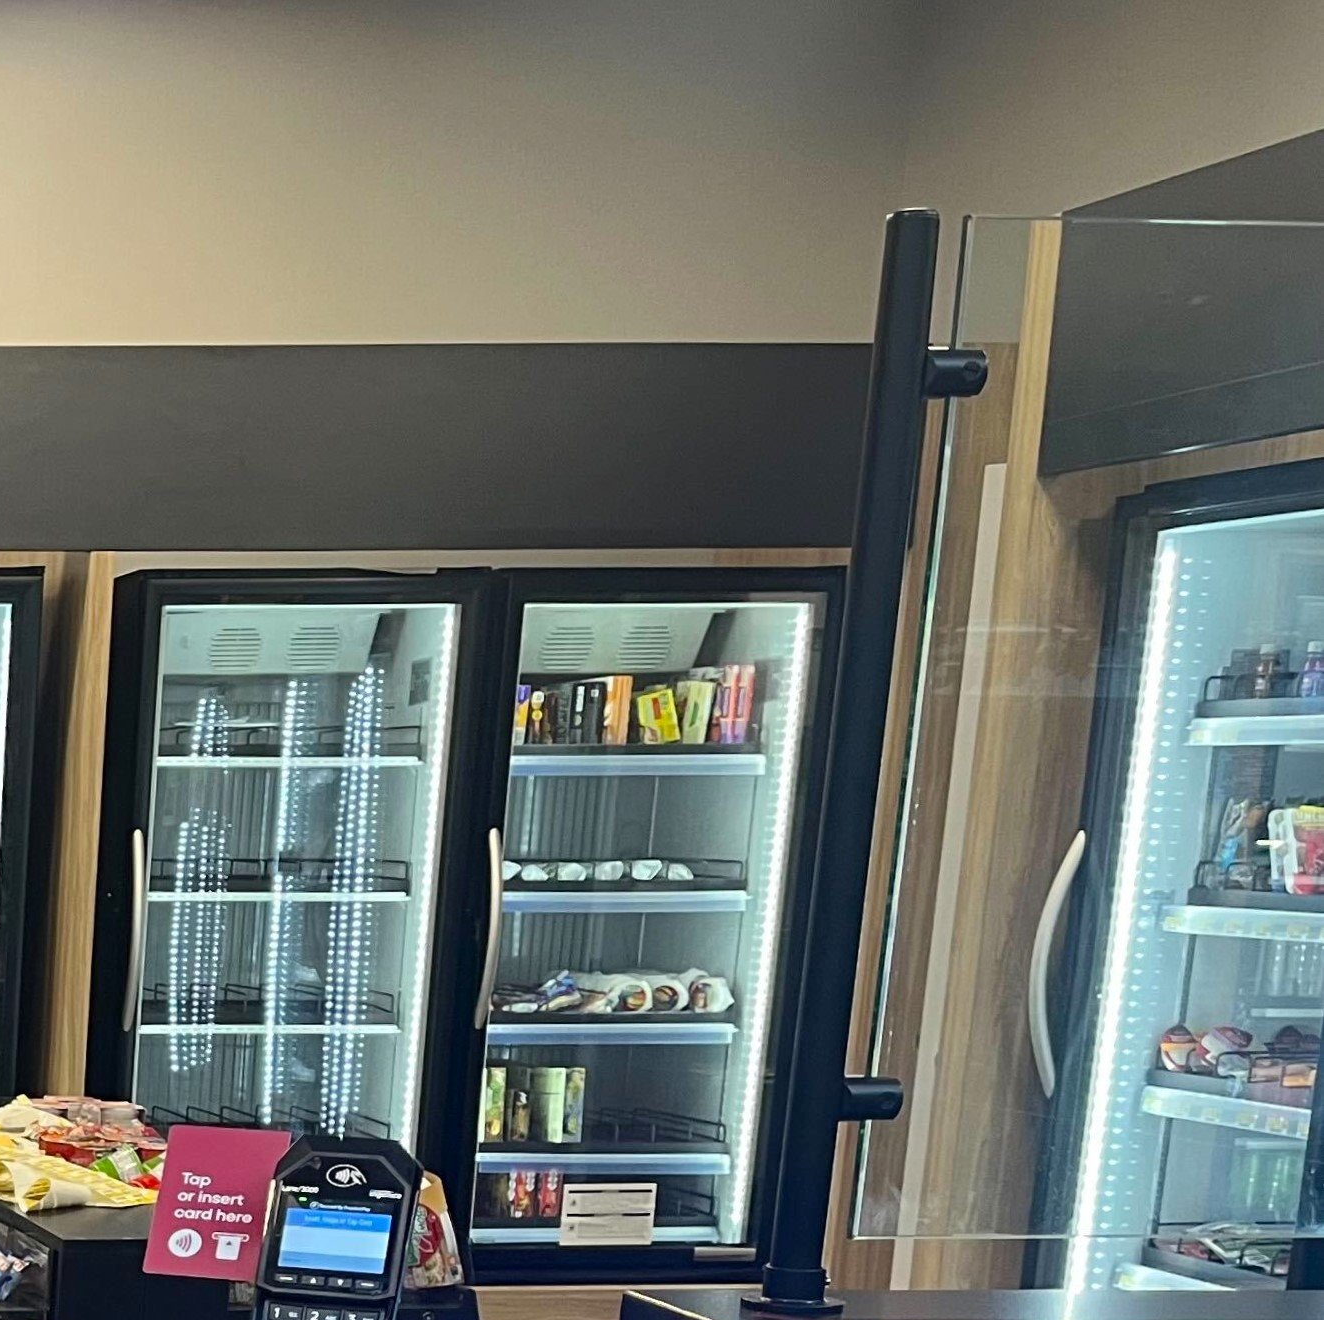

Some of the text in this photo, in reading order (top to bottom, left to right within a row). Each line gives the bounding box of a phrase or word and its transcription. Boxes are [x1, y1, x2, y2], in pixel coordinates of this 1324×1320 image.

[181, 1172, 211, 1188] Tap
[177, 1190, 244, 1206] or insert
[174, 1208, 253, 1224] card here
[274, 1307, 280, 1318] 1
